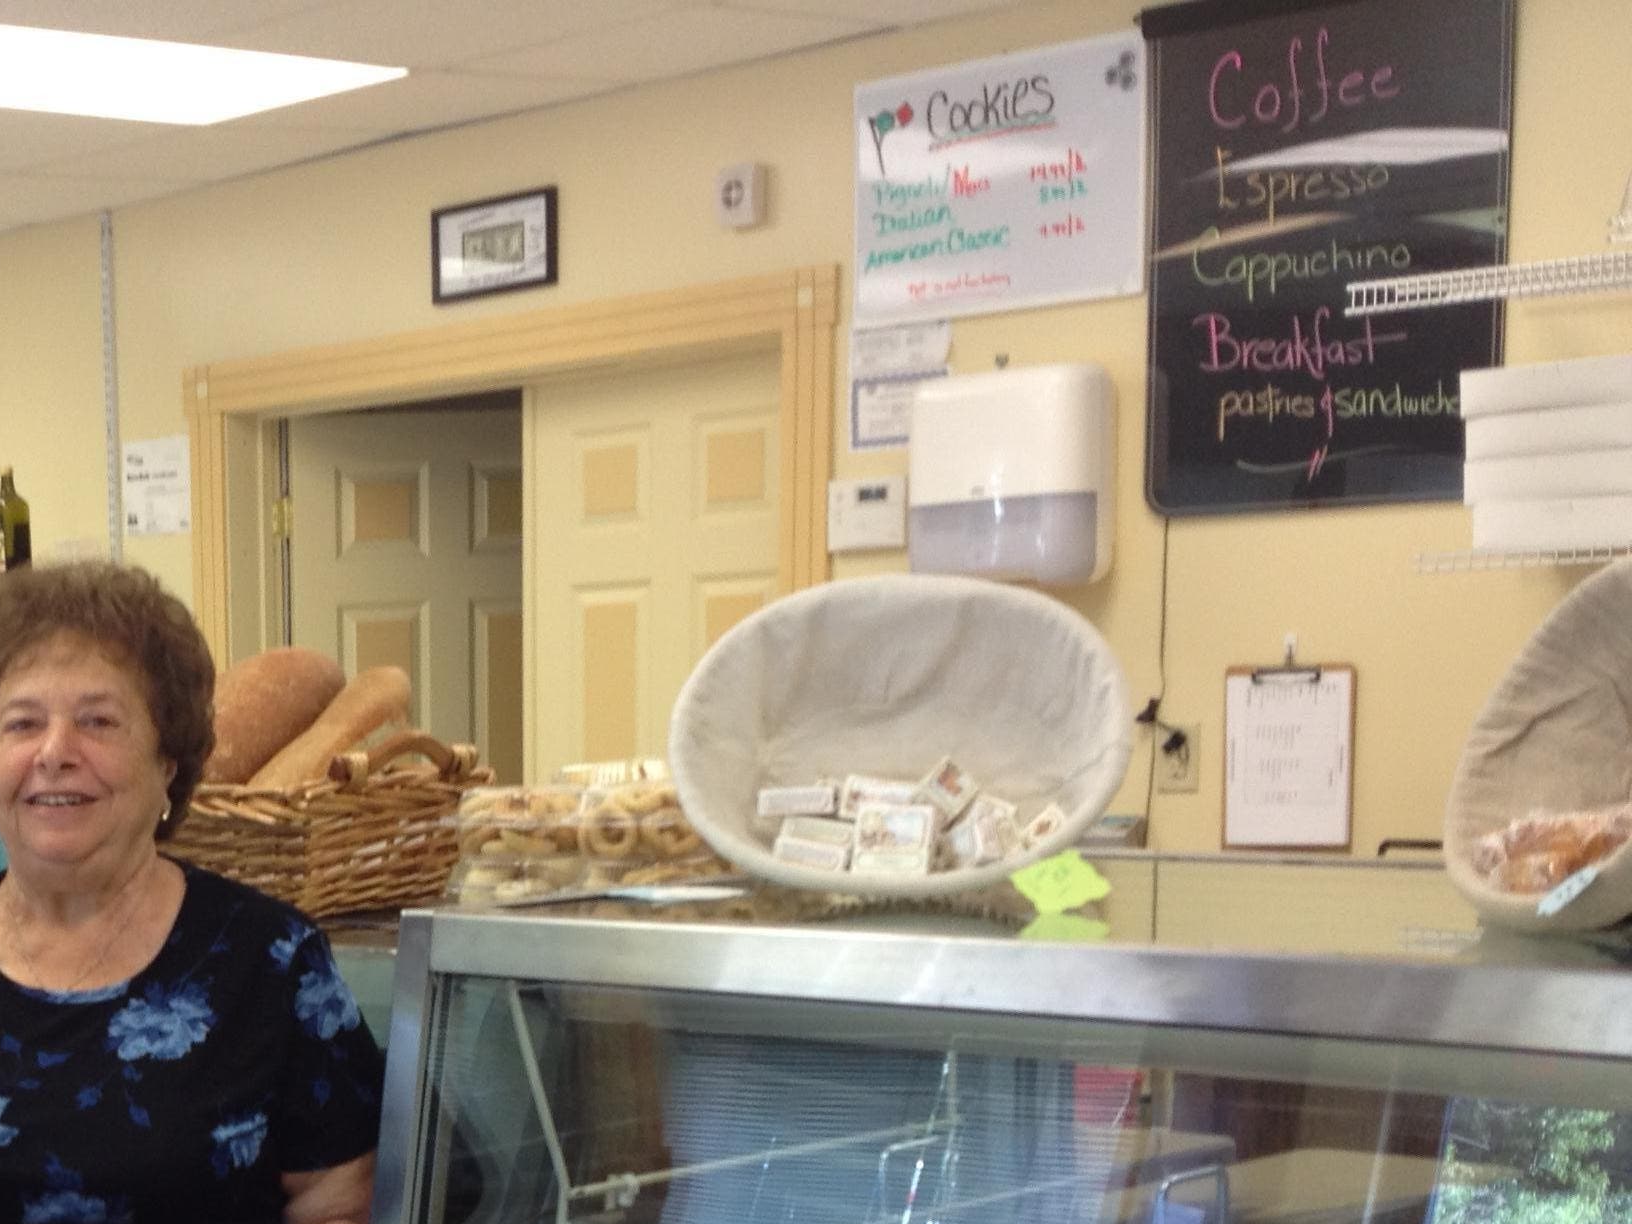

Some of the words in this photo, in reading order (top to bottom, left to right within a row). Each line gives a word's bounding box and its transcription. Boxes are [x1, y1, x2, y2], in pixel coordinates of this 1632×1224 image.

[926, 75, 1055, 139] Cookies
[1208, 27, 1402, 133] Coffee
[1216, 145, 1390, 226] Espresso
[1193, 226, 1411, 302] Cappuchino
[1192, 304, 1408, 381] Breakfast
[1218, 382, 1315, 442] pastries
